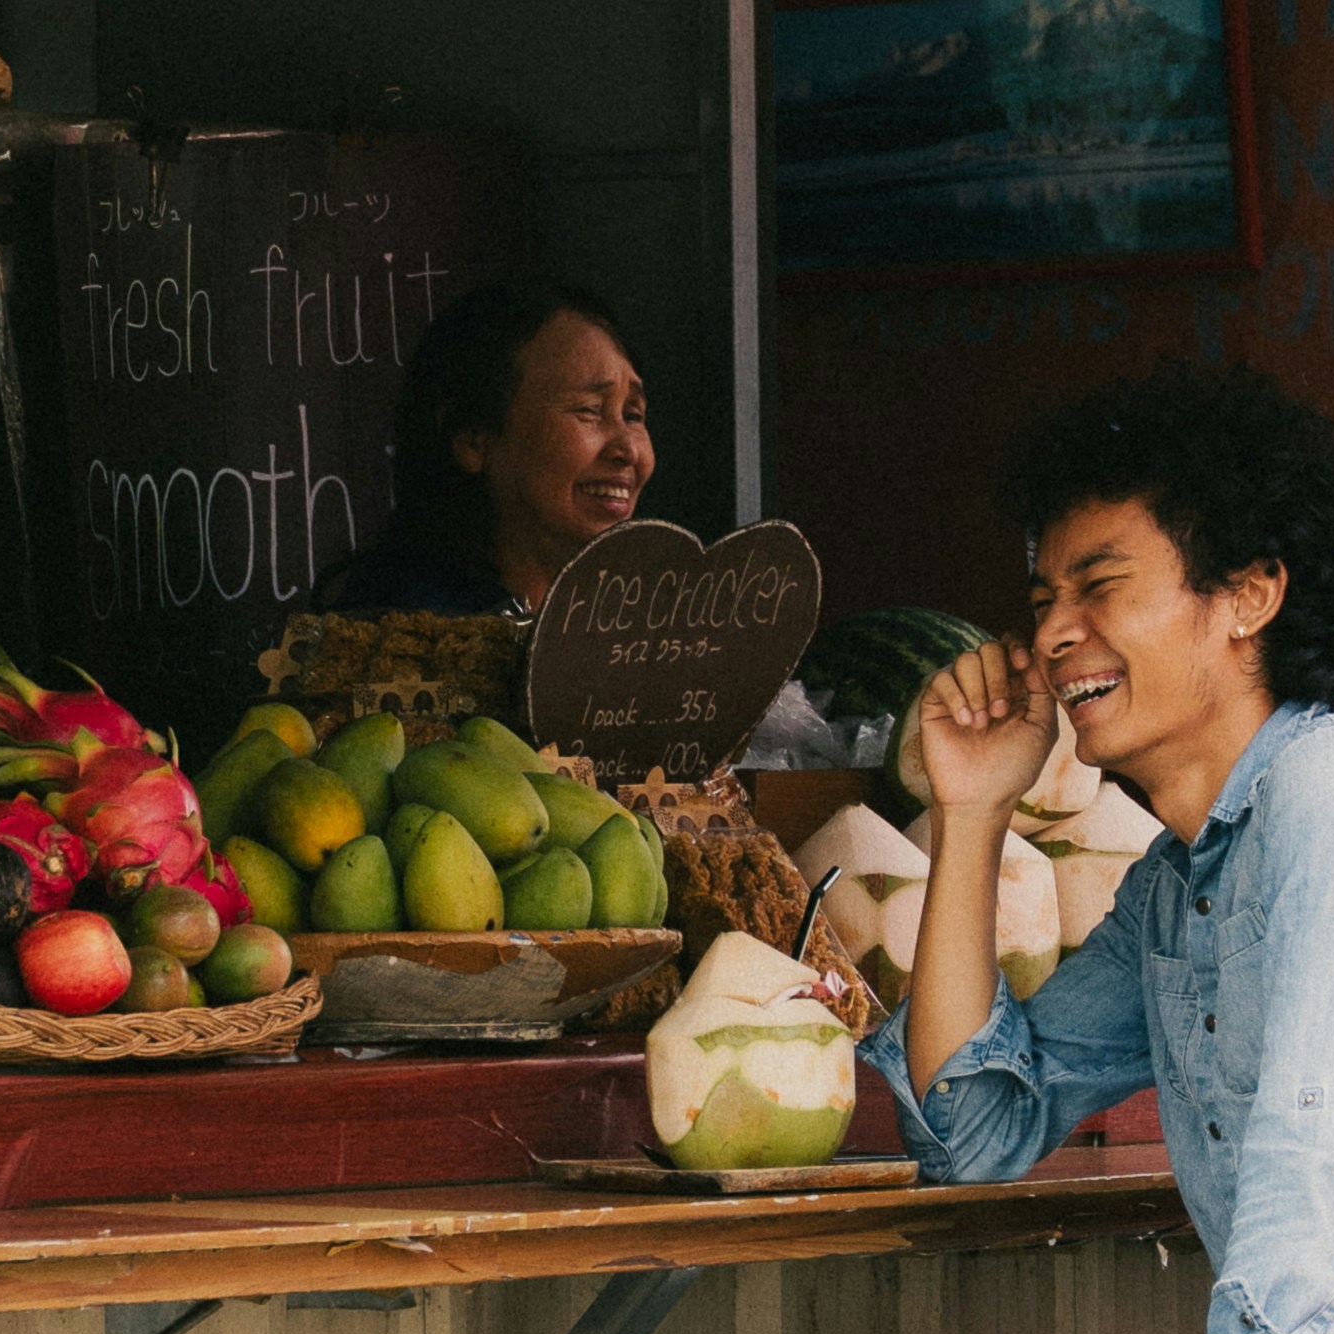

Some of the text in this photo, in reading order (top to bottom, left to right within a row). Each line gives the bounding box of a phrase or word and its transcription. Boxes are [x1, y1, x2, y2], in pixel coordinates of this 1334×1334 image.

[80, 222, 450, 382] fresh fruit
[562, 548, 799, 635] rice cracker
[591, 697, 639, 732] pack
